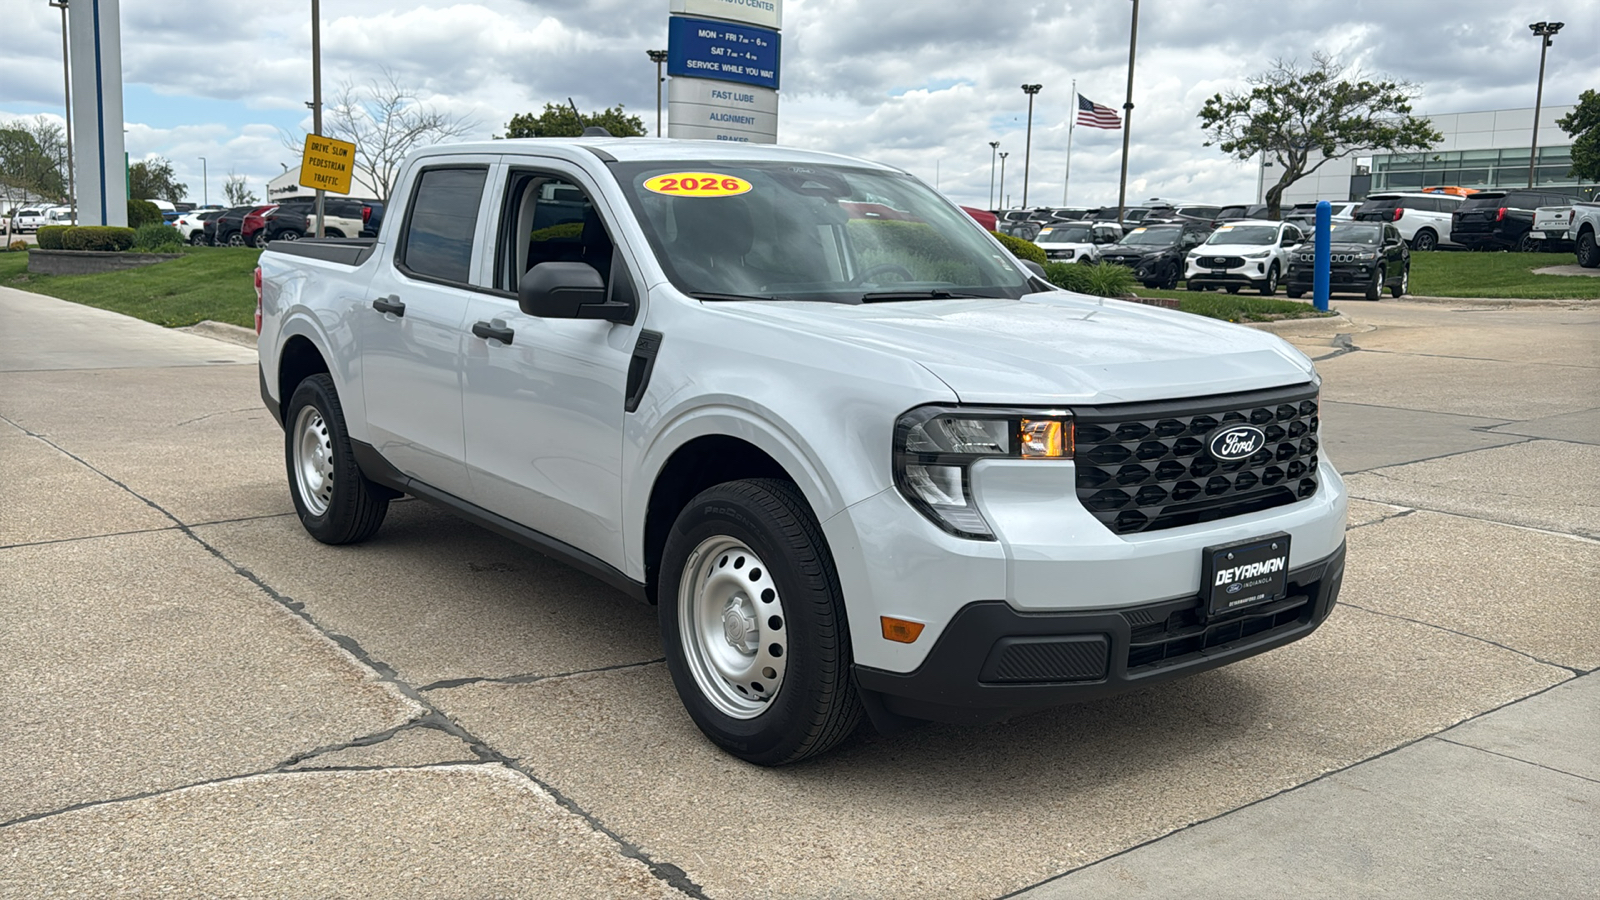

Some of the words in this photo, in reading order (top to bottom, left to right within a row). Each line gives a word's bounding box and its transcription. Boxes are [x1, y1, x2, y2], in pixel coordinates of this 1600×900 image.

[745, 0, 774, 12] CENTER
[698, 30, 716, 39] MON
[725, 33, 737, 42] FRI
[711, 46, 725, 56] SAT
[687, 59, 720, 71] SERVICE
[722, 63, 744, 74] WHILE
[745, 67, 759, 77] YOU
[760, 69, 774, 79] WAIT
[712, 90, 733, 100] FAST
[734, 93, 755, 104] LUBE
[709, 112, 756, 126] ALIGNMENT
[312, 142, 329, 153] DRIVE
[332, 146, 348, 157] SLOW
[309, 157, 345, 171] PEDESTRIAN
[314, 173, 338, 186] TRAFFIC
[659, 177, 740, 191] 2026
[1220, 430, 1257, 456] Ford
[1214, 556, 1286, 587] DEYARMAN
[1243, 576, 1273, 589] INDIANOLA
